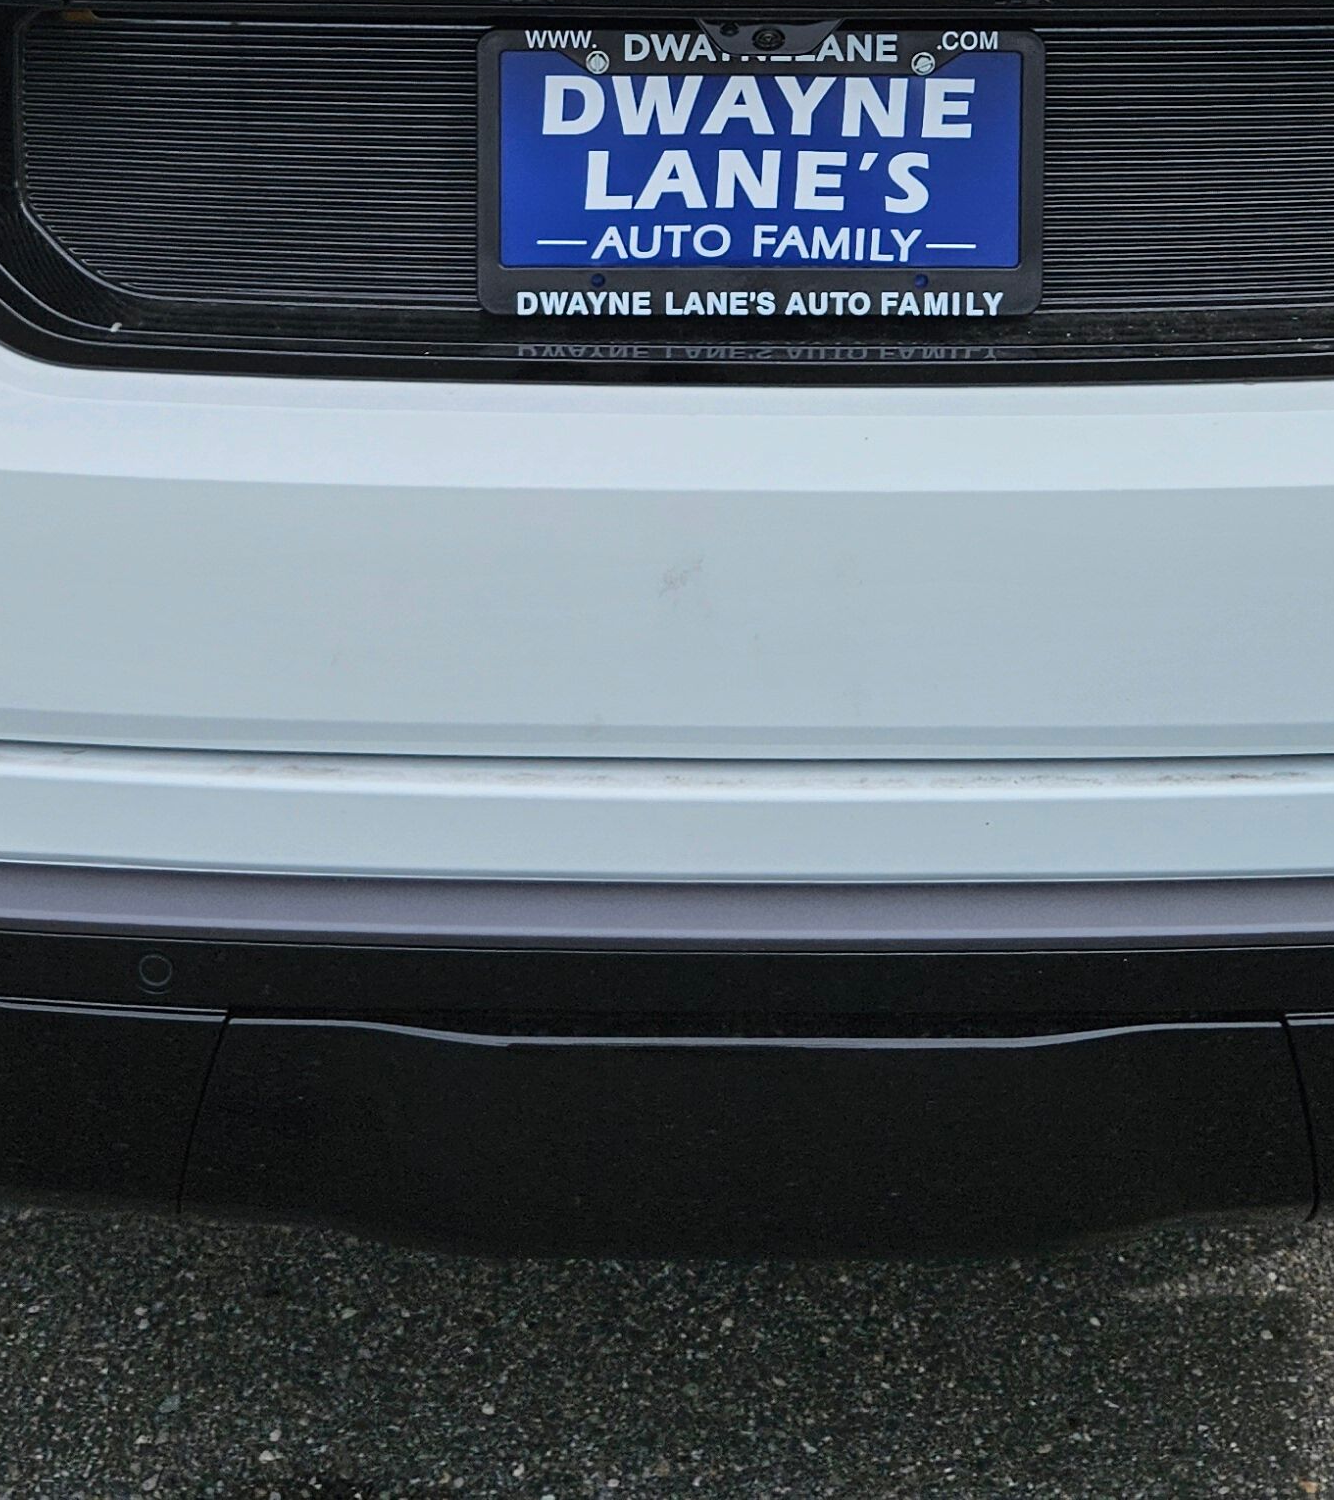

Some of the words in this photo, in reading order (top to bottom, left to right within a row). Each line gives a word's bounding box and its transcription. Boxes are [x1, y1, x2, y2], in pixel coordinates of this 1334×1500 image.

[525, 29, 597, 50] WWW.
[624, 33, 899, 62] DWAANE
[936, 30, 999, 51] .COM
[541, 75, 976, 139] DWAYNE
[584, 149, 930, 214] LANE'S
[590, 224, 732, 260] AUTO
[752, 226, 922, 263] FAMILY
[516, 291, 652, 316] DWAYNE
[665, 291, 777, 316] LANE'S
[784, 291, 871, 316] AUTO
[880, 291, 1004, 316] FAMILY
